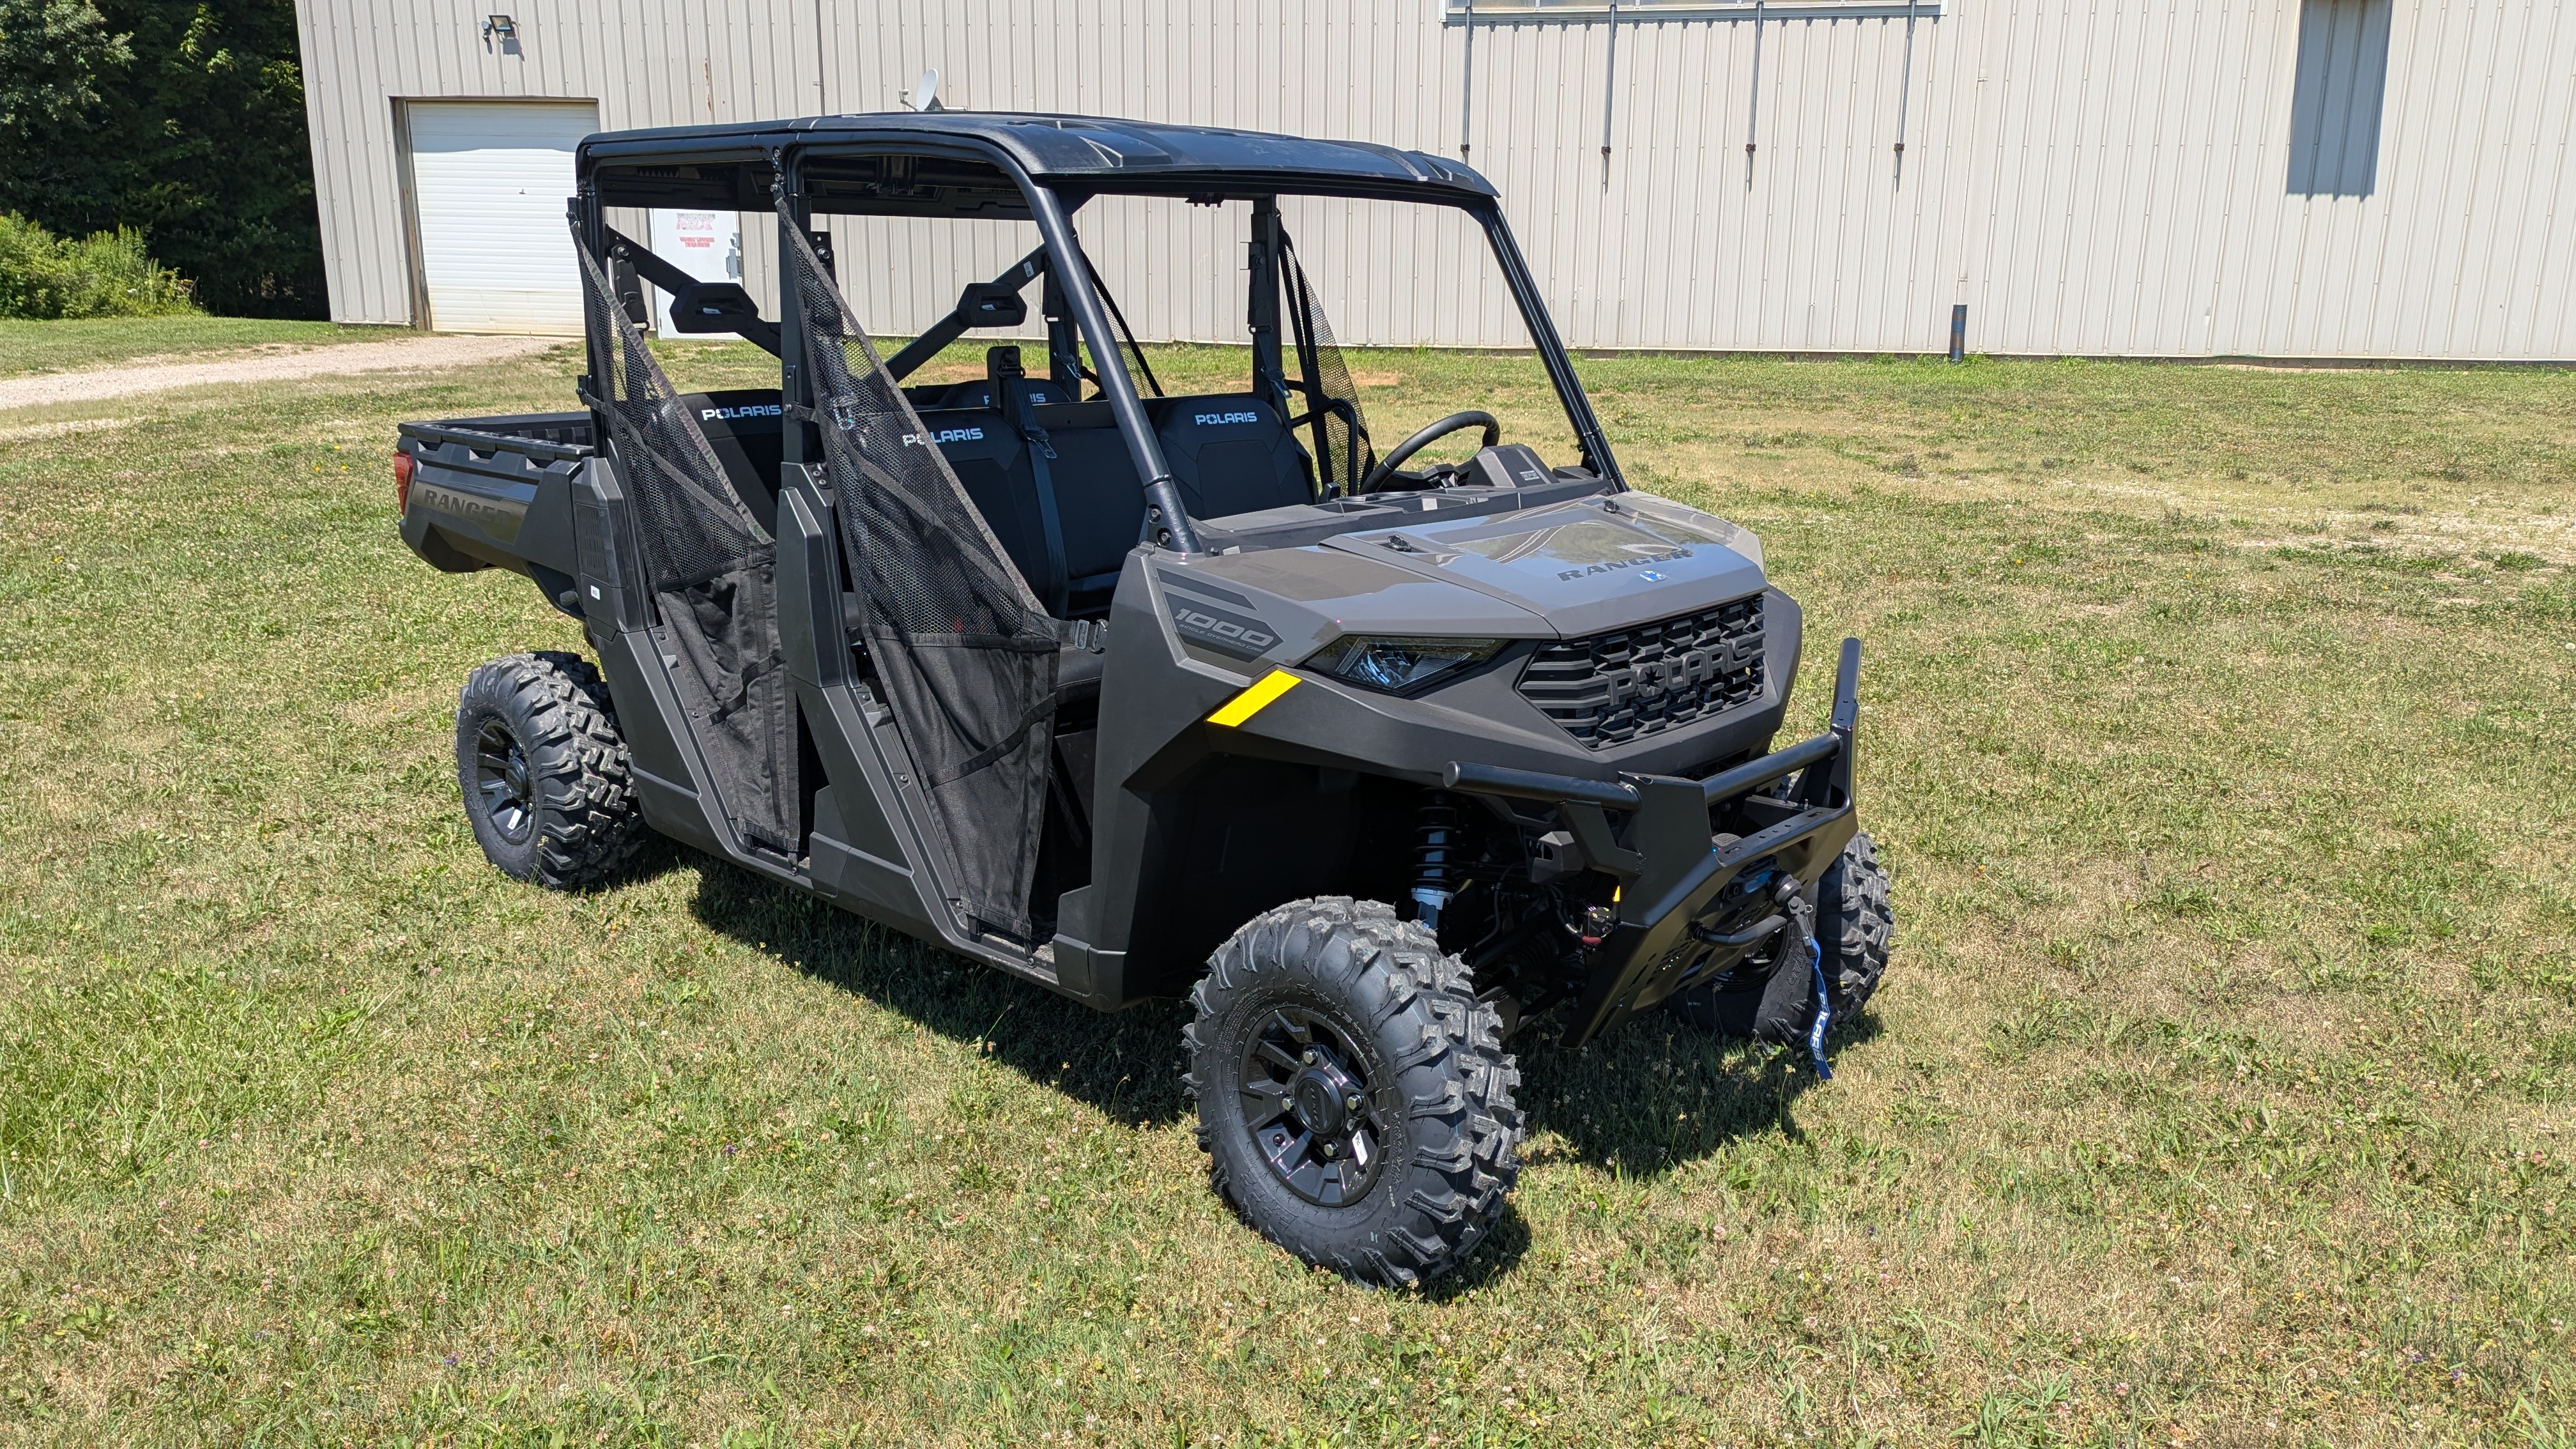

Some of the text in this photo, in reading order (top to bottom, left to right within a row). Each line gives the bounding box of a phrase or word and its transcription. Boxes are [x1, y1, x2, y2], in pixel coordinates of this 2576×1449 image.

[701, 404, 782, 421] POLARIS
[1195, 412, 1257, 425] POLARIS
[424, 489, 511, 525] RANGER
[1556, 549, 1693, 581] RANGER
[1175, 608, 1274, 647] 1000
[1179, 624, 1264, 653] SINGLE OVERHEAD CAM
[1607, 638, 1753, 707] POLARIS
